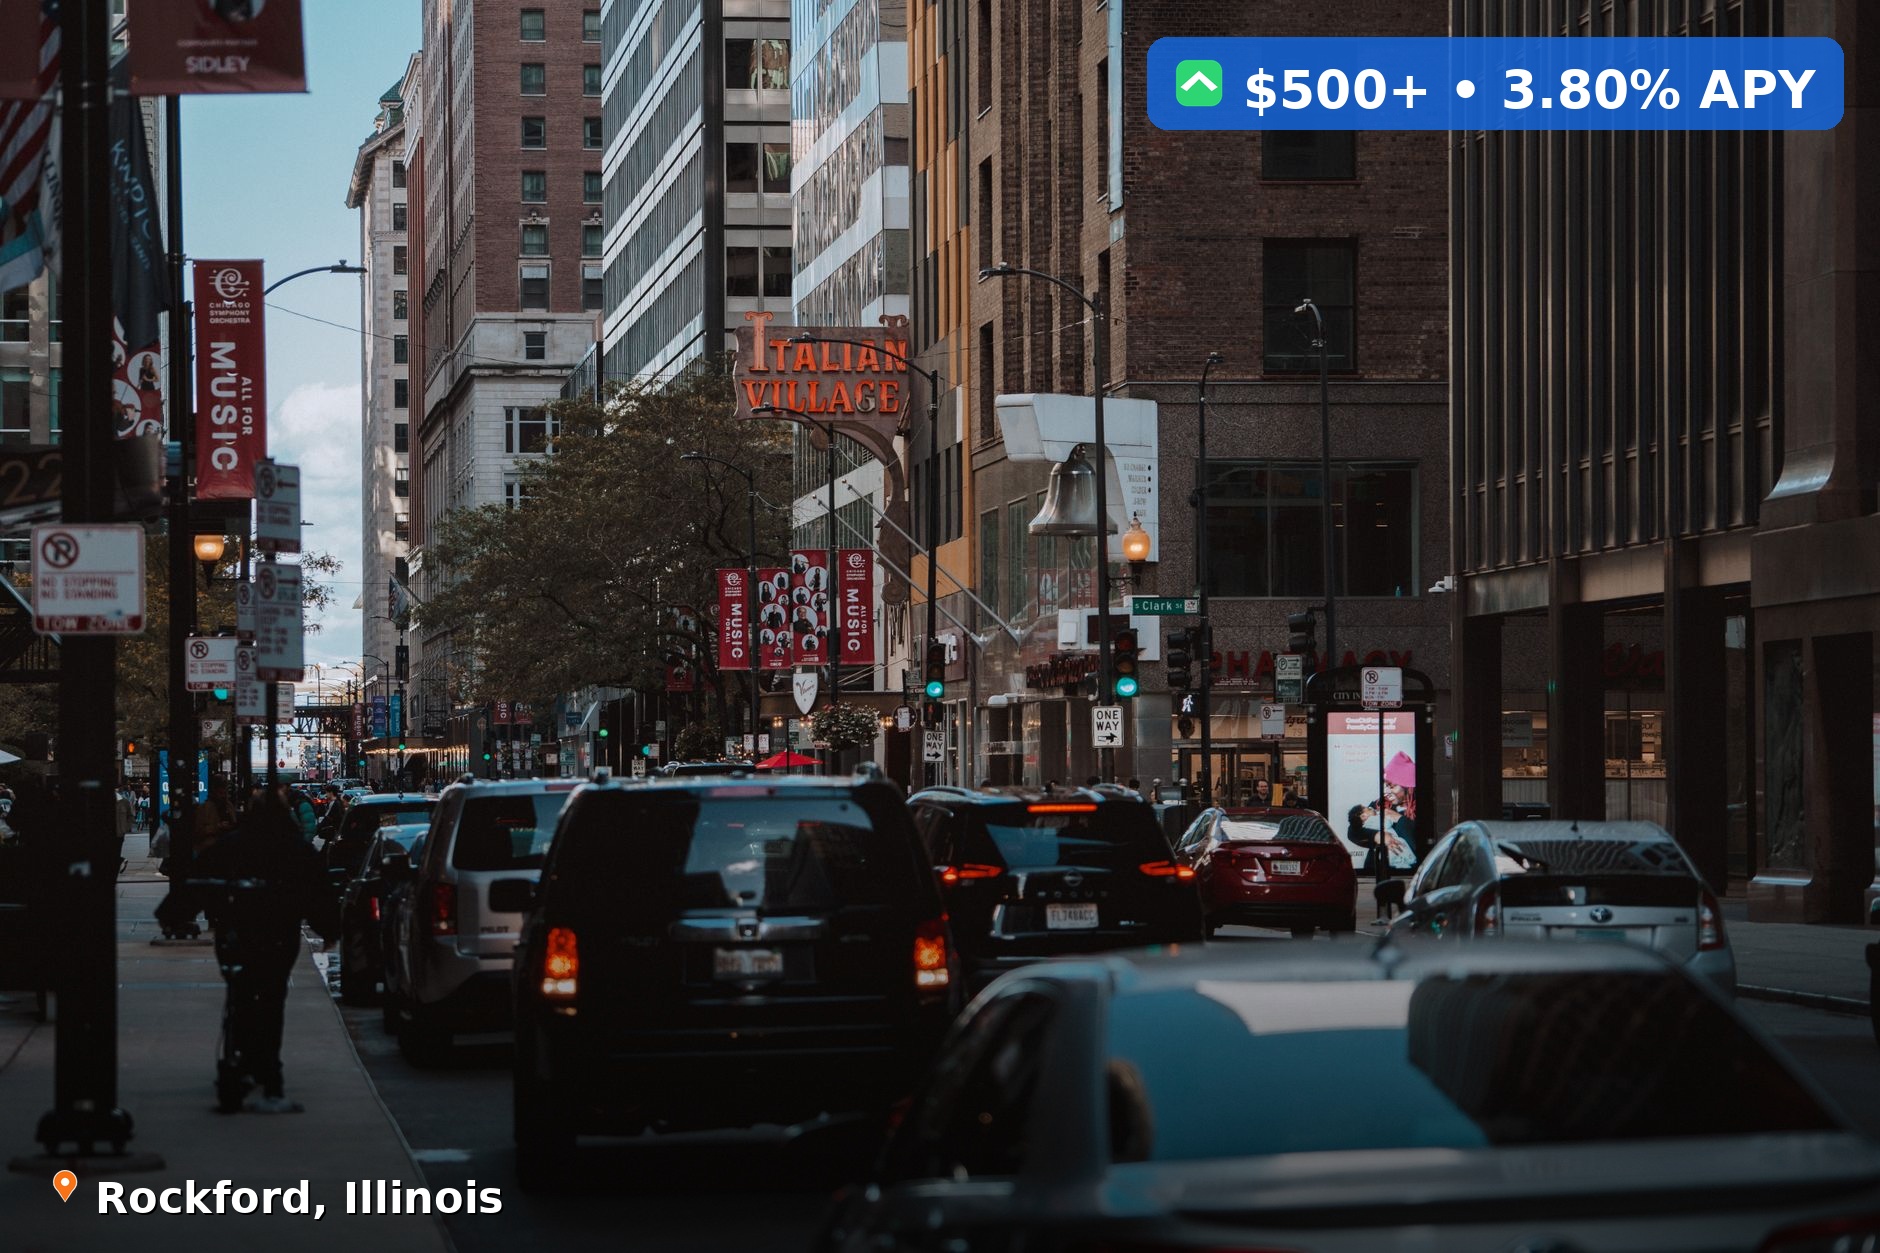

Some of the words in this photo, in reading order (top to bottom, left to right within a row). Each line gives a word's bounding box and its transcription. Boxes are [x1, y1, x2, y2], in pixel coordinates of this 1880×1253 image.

[185, 56, 250, 74] SIDLEY
[745, 311, 907, 373] ITALIAN
[241, 376, 252, 401] ALL
[741, 379, 900, 414] VILLAGE
[210, 341, 238, 471] MUSIC
[242, 407, 253, 435] FOR
[1142, 601, 1172, 610] Clark
[44, 616, 77, 631] TOW
[88, 616, 129, 631] ZONE
[847, 588, 861, 651] MUSIC
[731, 603, 743, 658] MUSIC
[1333, 691, 1350, 700] CITY
[1097, 710, 1119, 719] ONE
[1096, 721, 1119, 730] WAY
[926, 733, 943, 741] ONE
[926, 742, 943, 750] WAY
